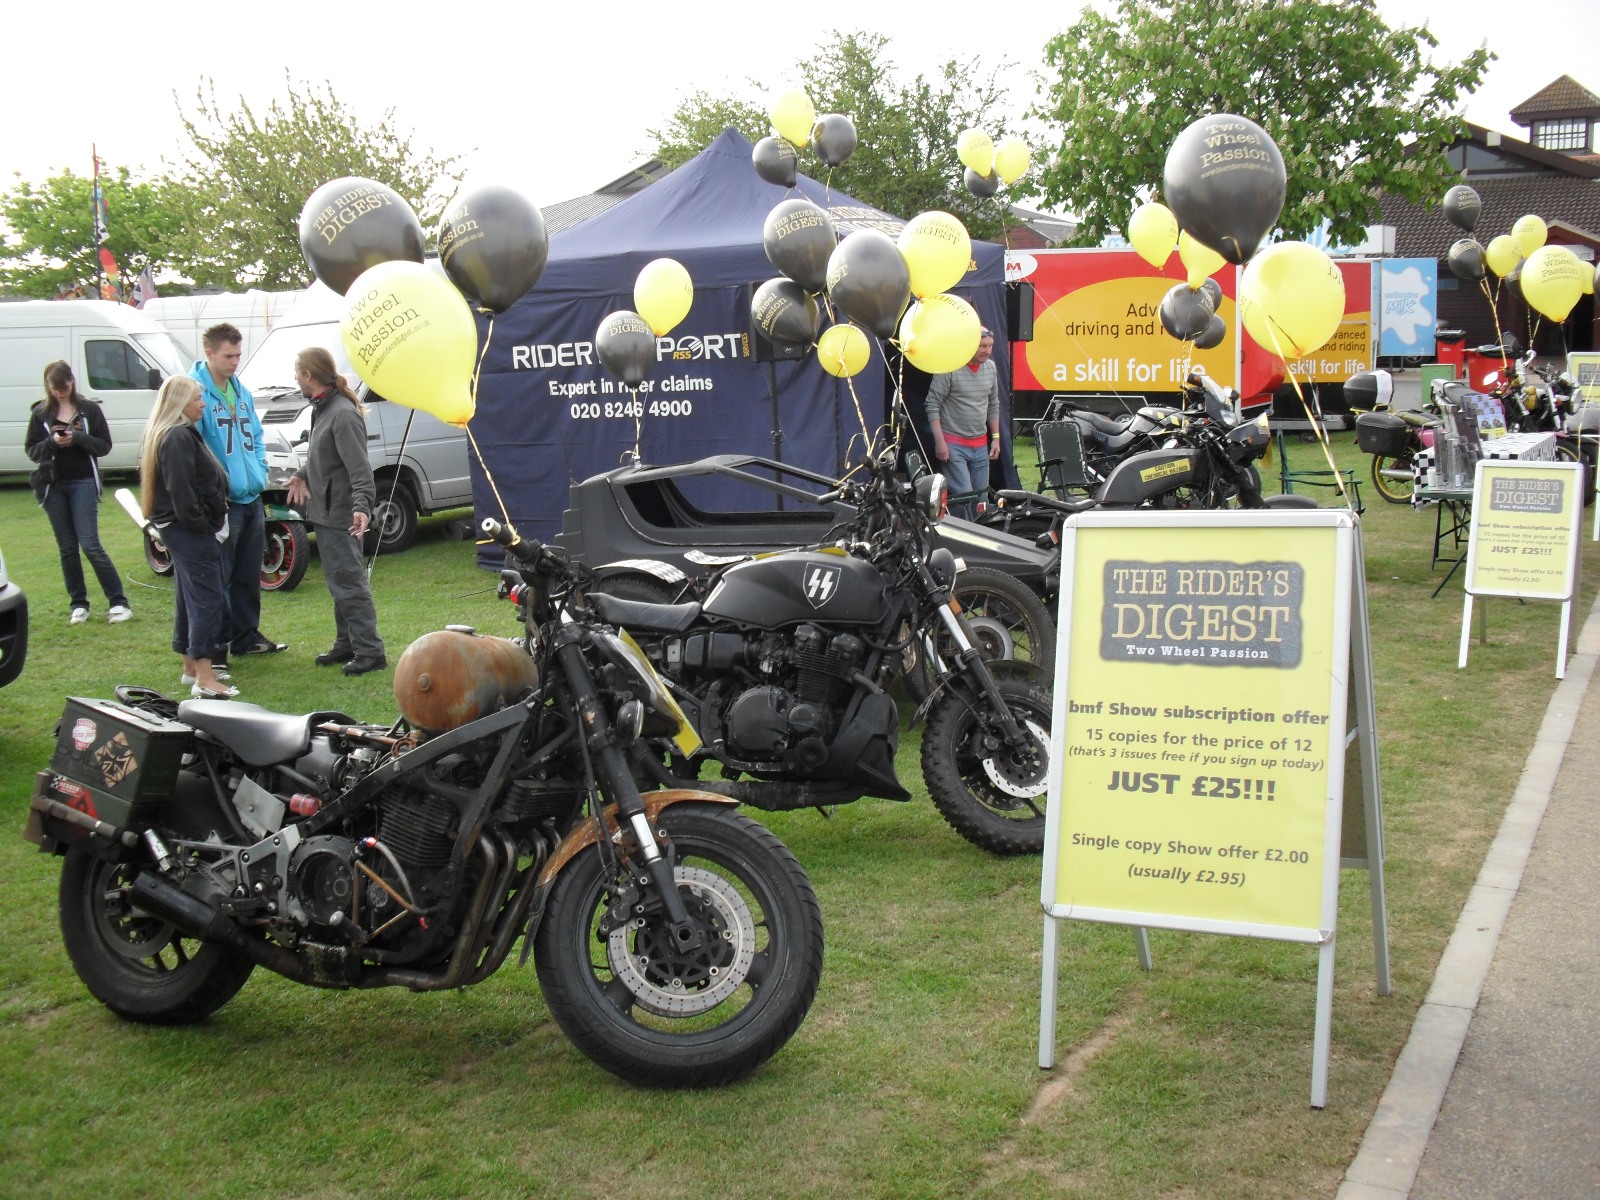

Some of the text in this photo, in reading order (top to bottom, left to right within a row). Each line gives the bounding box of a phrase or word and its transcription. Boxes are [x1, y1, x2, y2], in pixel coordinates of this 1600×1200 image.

[1203, 133, 1262, 148] Wheel
[1206, 123, 1246, 134] Two
[1200, 146, 1272, 168] Passion
[313, 205, 336, 230] THE
[320, 193, 393, 246] DIGEST
[774, 215, 790, 230] THE
[776, 216, 824, 240] DIGEST
[350, 293, 402, 341] Wheel
[756, 292, 778, 321] Wheel
[761, 297, 788, 332] Passion
[357, 308, 421, 367] Passion
[609, 323, 651, 337] DIGEST
[1066, 321, 1120, 339] driving
[1125, 321, 1154, 336] and
[1331, 330, 1366, 339] vanced
[512, 341, 593, 369] RIDER
[673, 351, 692, 360] RSS
[741, 332, 750, 357] SERVICES
[1319, 342, 1366, 354] and riding
[1053, 358, 1206, 382] a skill for life
[1290, 359, 1366, 375] skill for life
[549, 379, 597, 398] Expert
[601, 377, 614, 394] in
[661, 374, 714, 391] claims
[570, 399, 692, 419] 020 8246 4900
[217, 417, 254, 455] 75
[1495, 480, 1559, 491] THE RIDER'S
[1494, 491, 1559, 506] DIGEST
[1491, 545, 1552, 555] JUST £25!!!
[1112, 568, 1290, 597] THE RIDER'S
[1111, 603, 1290, 643] DIGEST
[1126, 643, 1269, 660] Two Wheel Passion
[1068, 700, 1329, 725] bmf Show subscription offer
[1086, 728, 1312, 752] 15 copies for the price of 12
[1069, 745, 1325, 772] (that's 3 issues free if you sign up today)
[1108, 770, 1276, 801] JUST £25!!!
[1072, 832, 1309, 864] Single copy Show offer £2.00
[1128, 863, 1246, 888] (usually £2.95)
